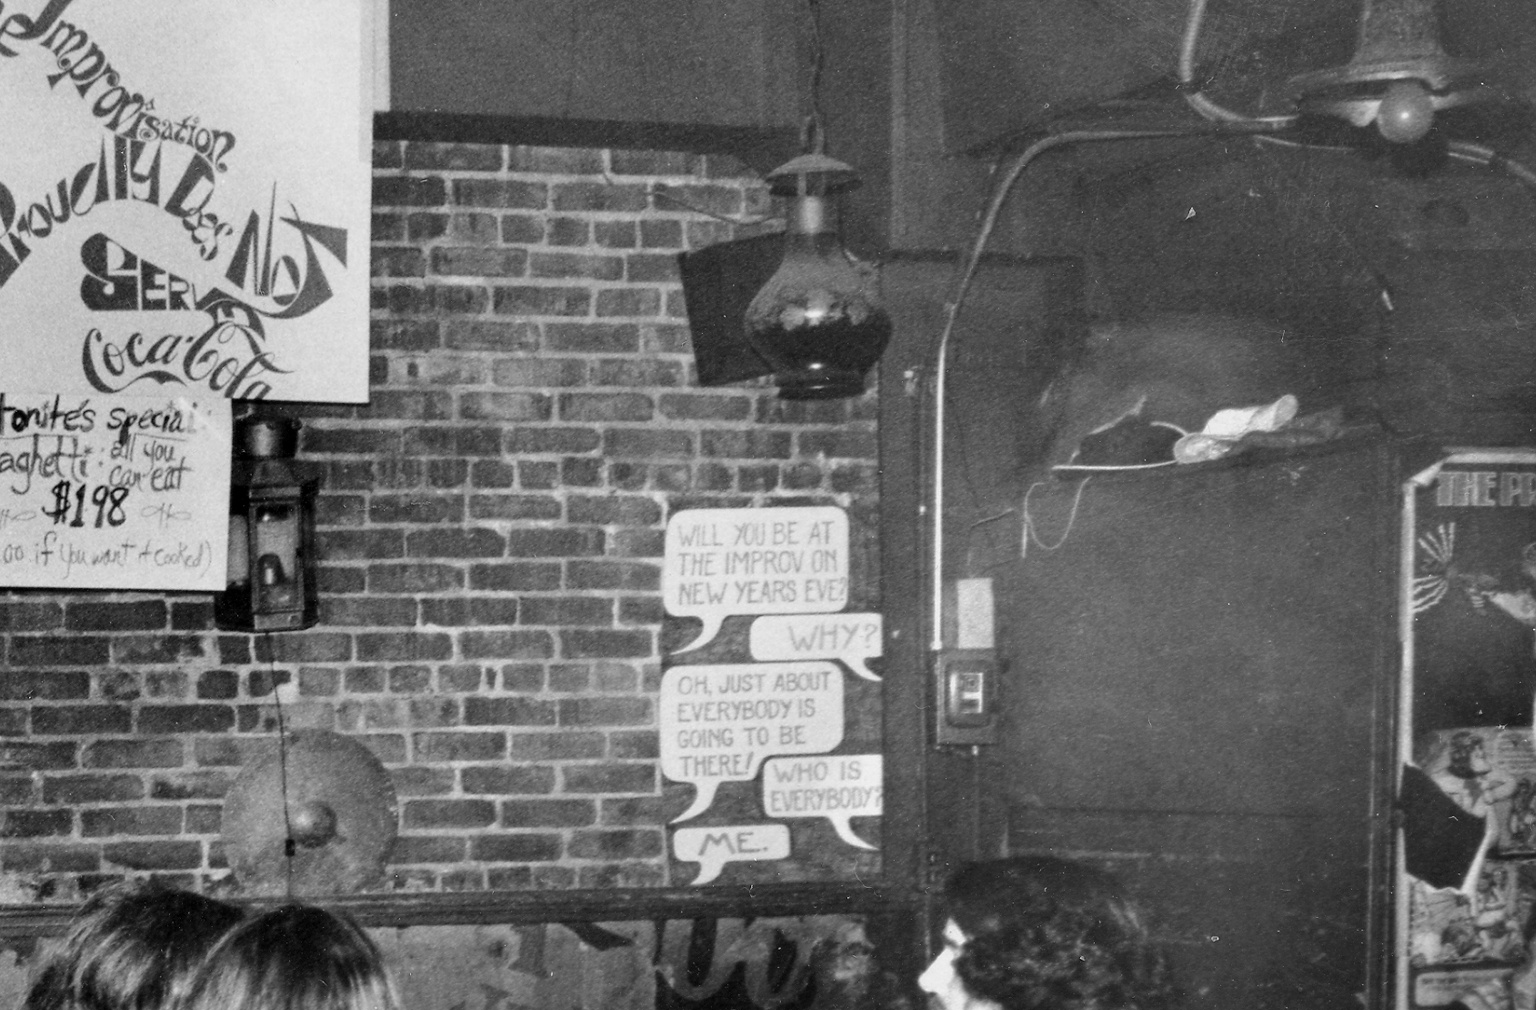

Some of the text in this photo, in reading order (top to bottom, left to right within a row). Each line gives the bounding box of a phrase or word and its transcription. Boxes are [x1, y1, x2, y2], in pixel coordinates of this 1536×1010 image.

[82, 321, 296, 399] Coca-Cola
[151, 456, 195, 492] eat
[1436, 471, 1497, 507] THE
[677, 520, 835, 547] WILL YOU BE AT
[677, 549, 838, 577] THE IMPROV ON
[678, 576, 847, 606] NEW YEARS EVE?
[788, 622, 879, 652] WHY?
[677, 671, 832, 697] OH, JUST ABOUT
[677, 698, 816, 723] EVERYBODY IS
[676, 725, 807, 749] GOING TO BE
[679, 751, 755, 777] THERE!
[772, 760, 862, 784] WHO IS
